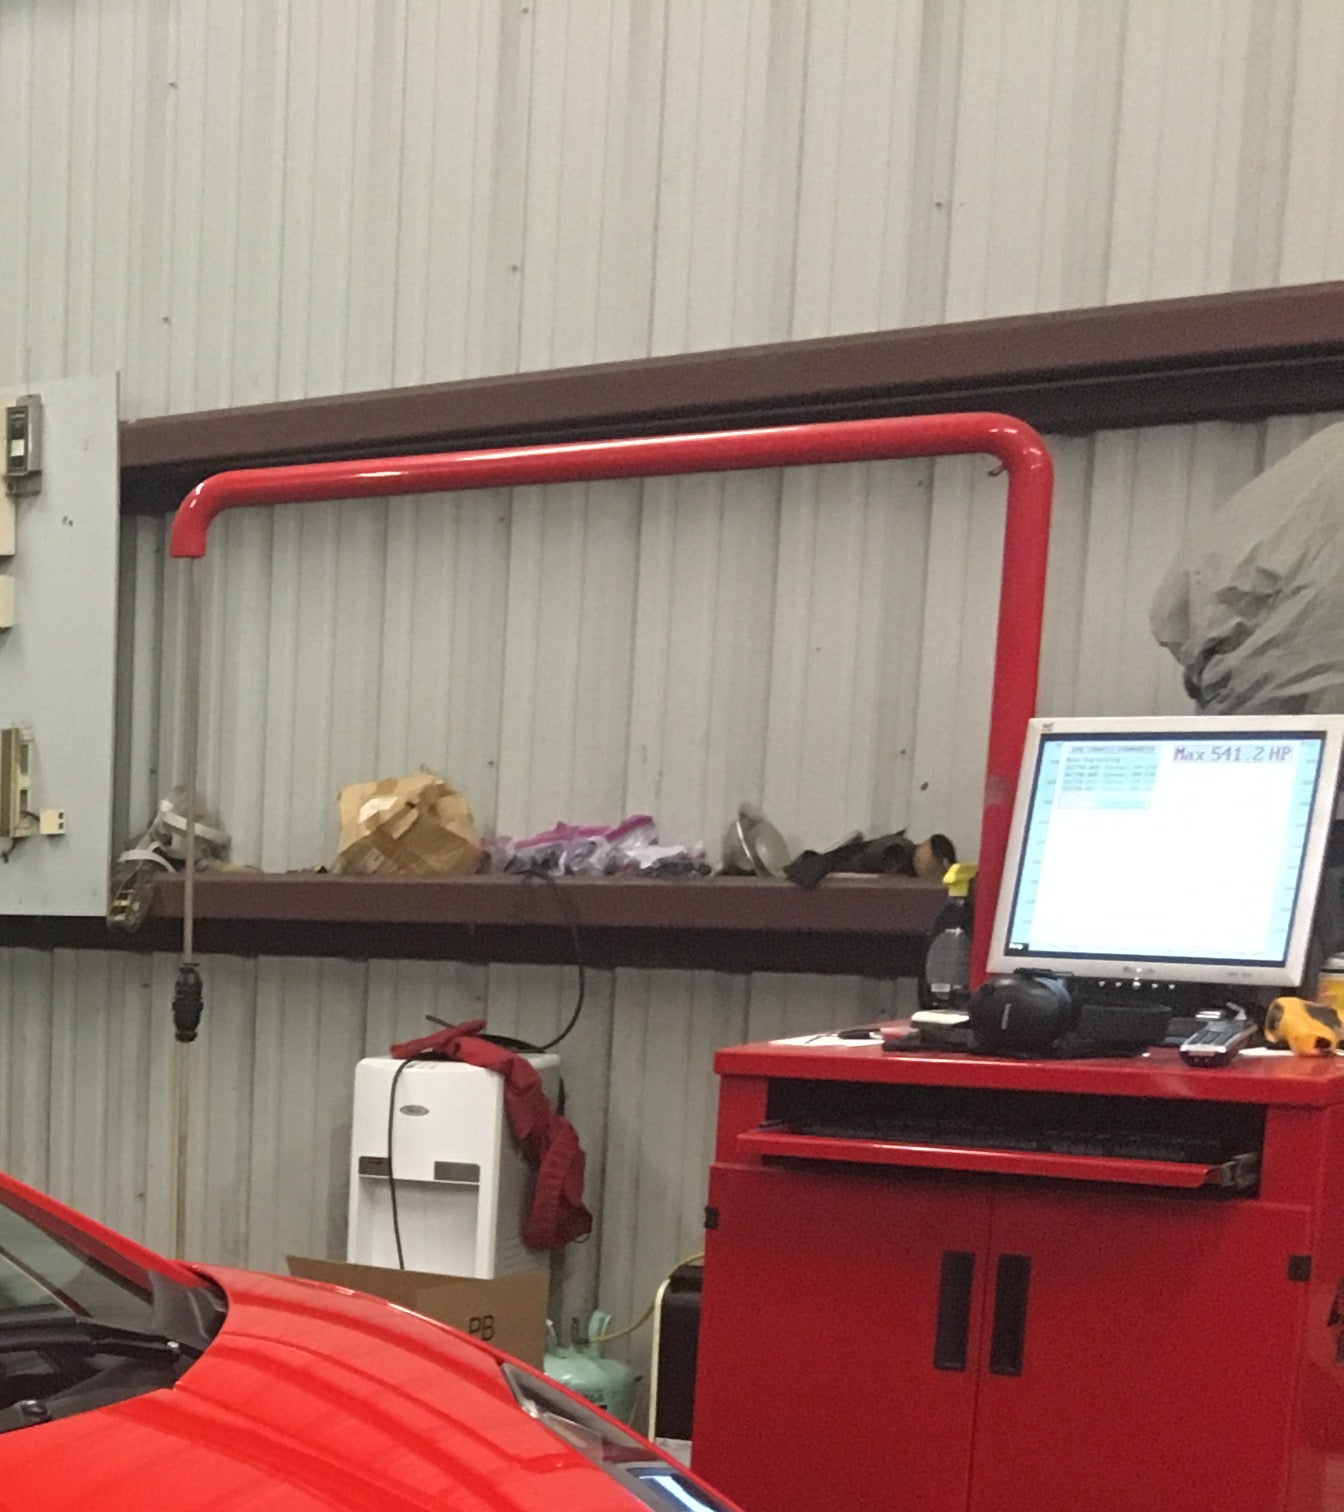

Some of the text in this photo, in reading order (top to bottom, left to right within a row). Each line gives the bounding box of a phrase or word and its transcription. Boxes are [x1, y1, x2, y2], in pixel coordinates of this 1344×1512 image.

[1173, 746, 1204, 761] Max
[1211, 745, 1265, 761] 541.2
[1269, 745, 1293, 761] HP
